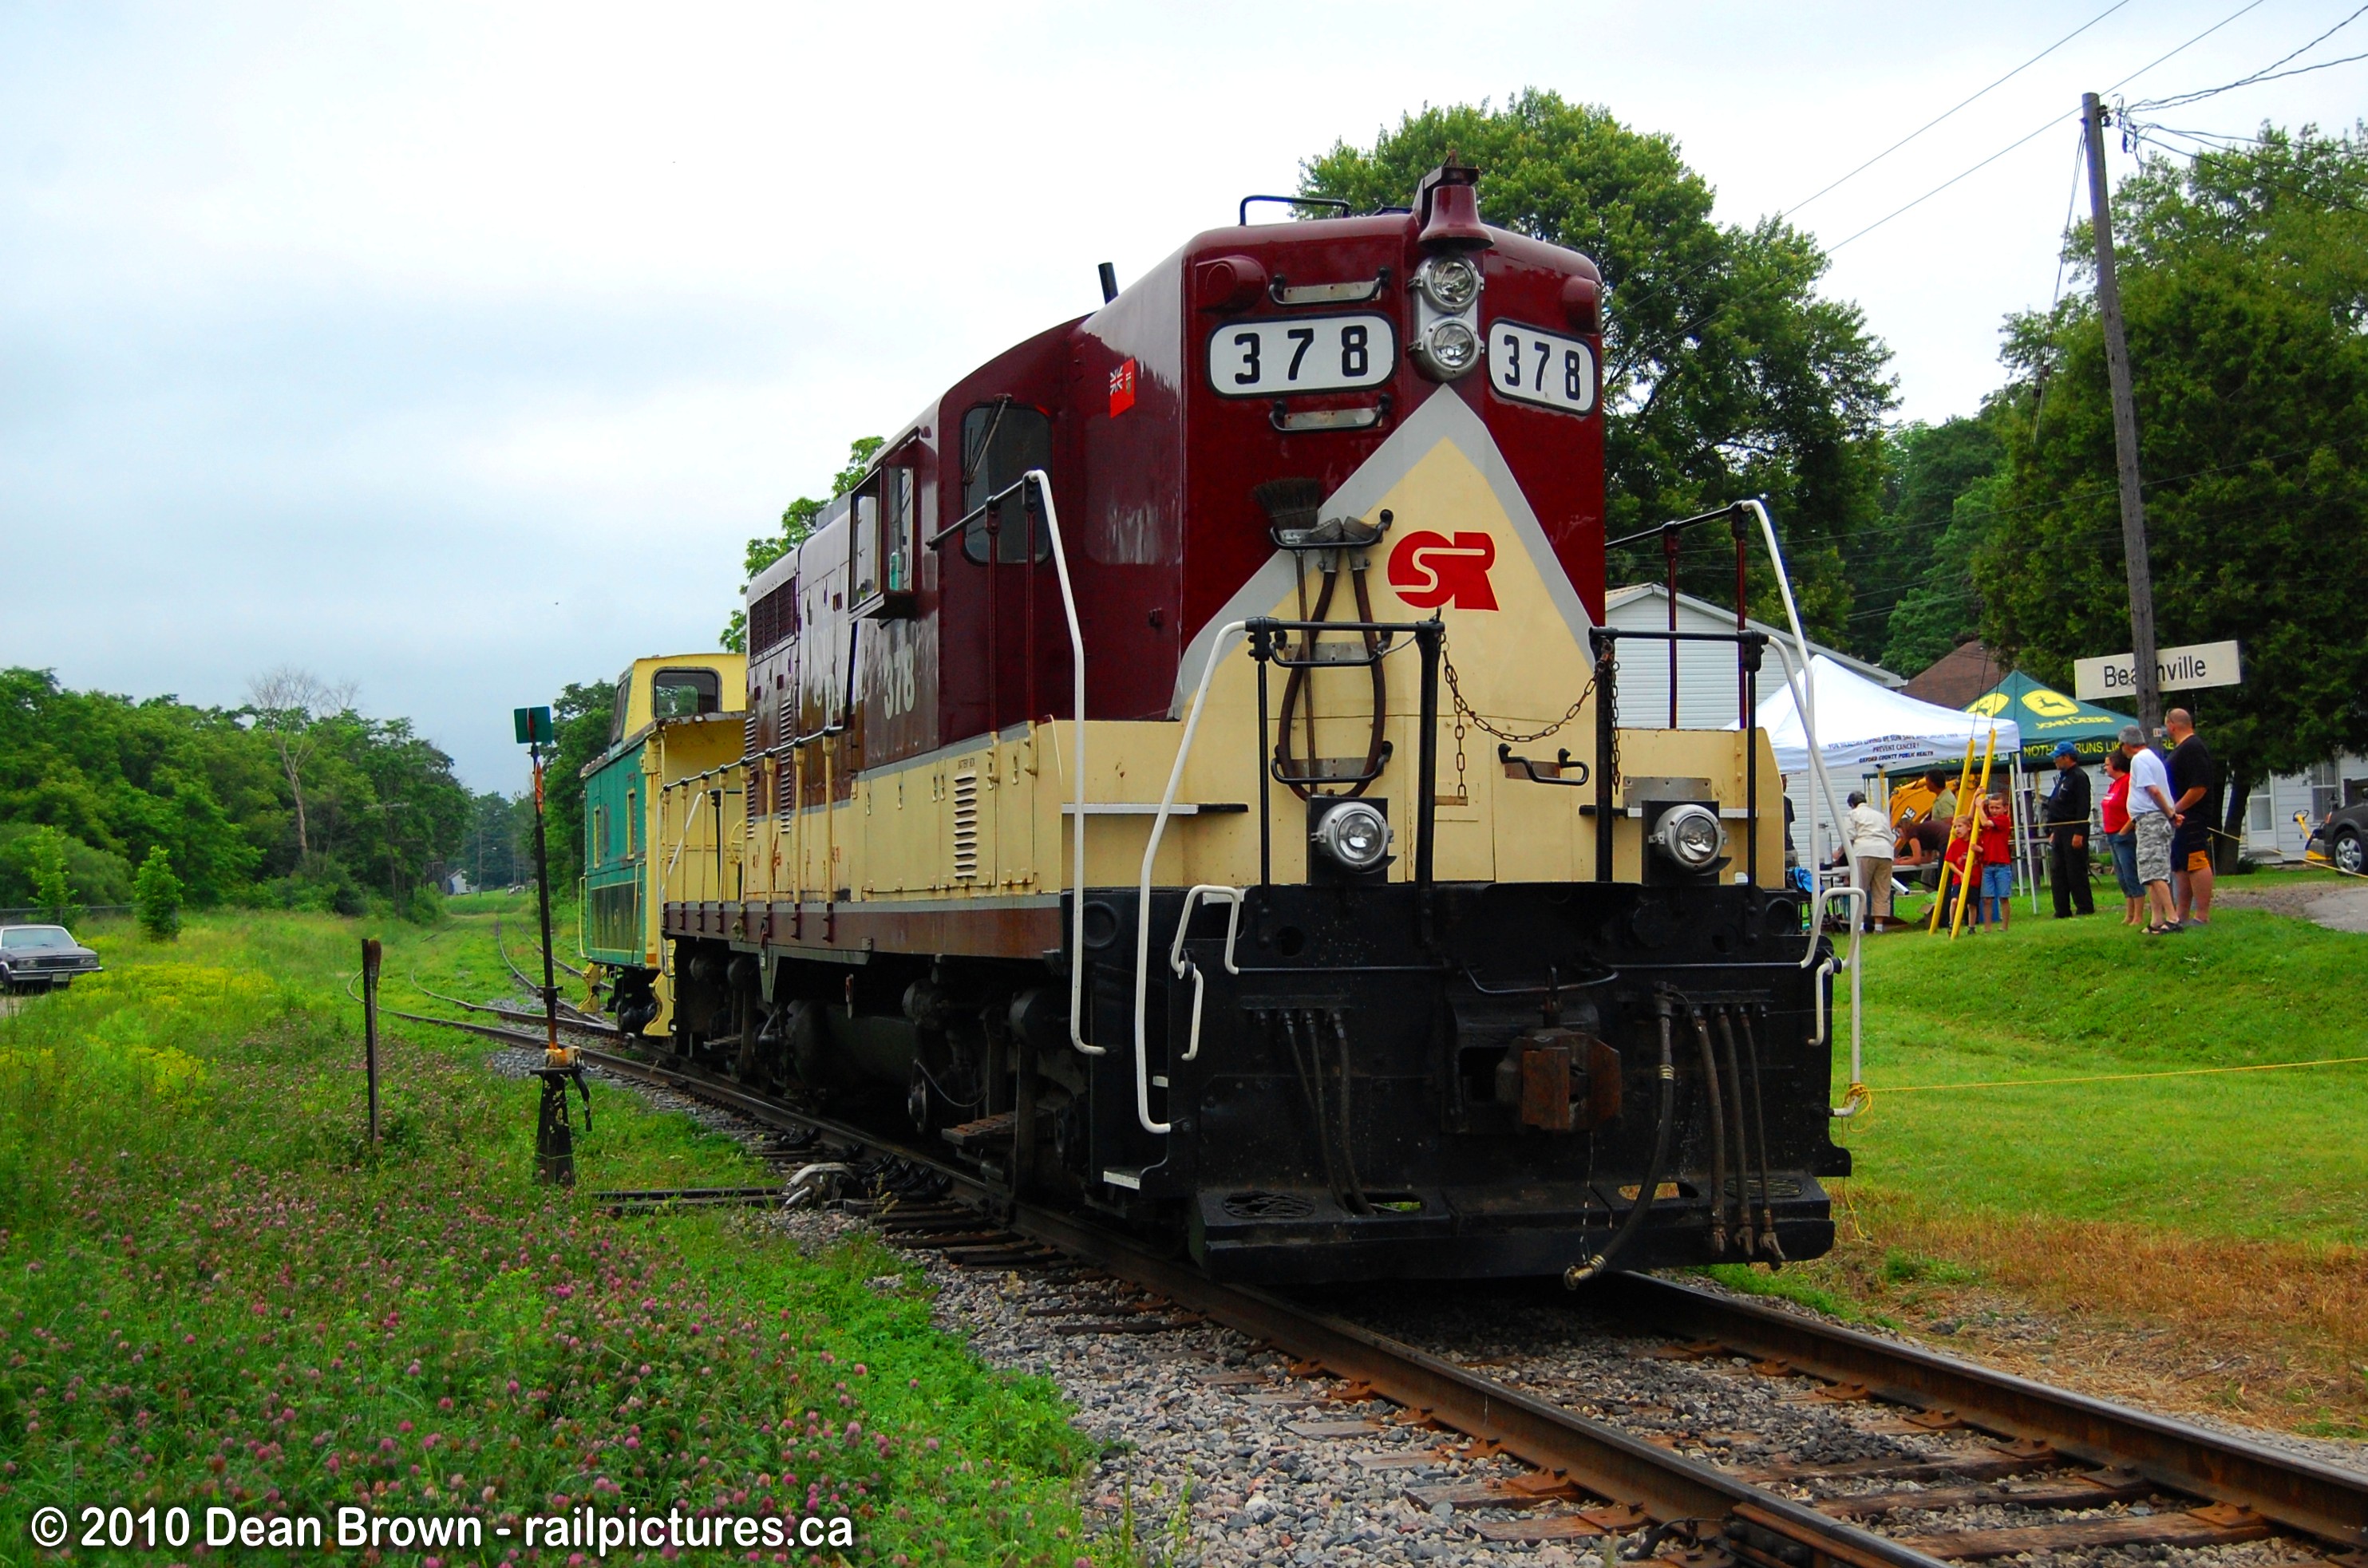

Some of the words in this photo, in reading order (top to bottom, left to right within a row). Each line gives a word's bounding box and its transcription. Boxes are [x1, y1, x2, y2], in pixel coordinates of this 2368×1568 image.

[1234, 324, 1368, 385] 378
[1504, 334, 1580, 401] 378
[884, 643, 915, 720] 378
[1859, 755, 1877, 764] OXFORD
[1879, 752, 1897, 761] COUNTY
[1872, 744, 1895, 752] PREVENT
[2074, 741, 2103, 753] RUNS
[2105, 741, 2120, 752] LIK
